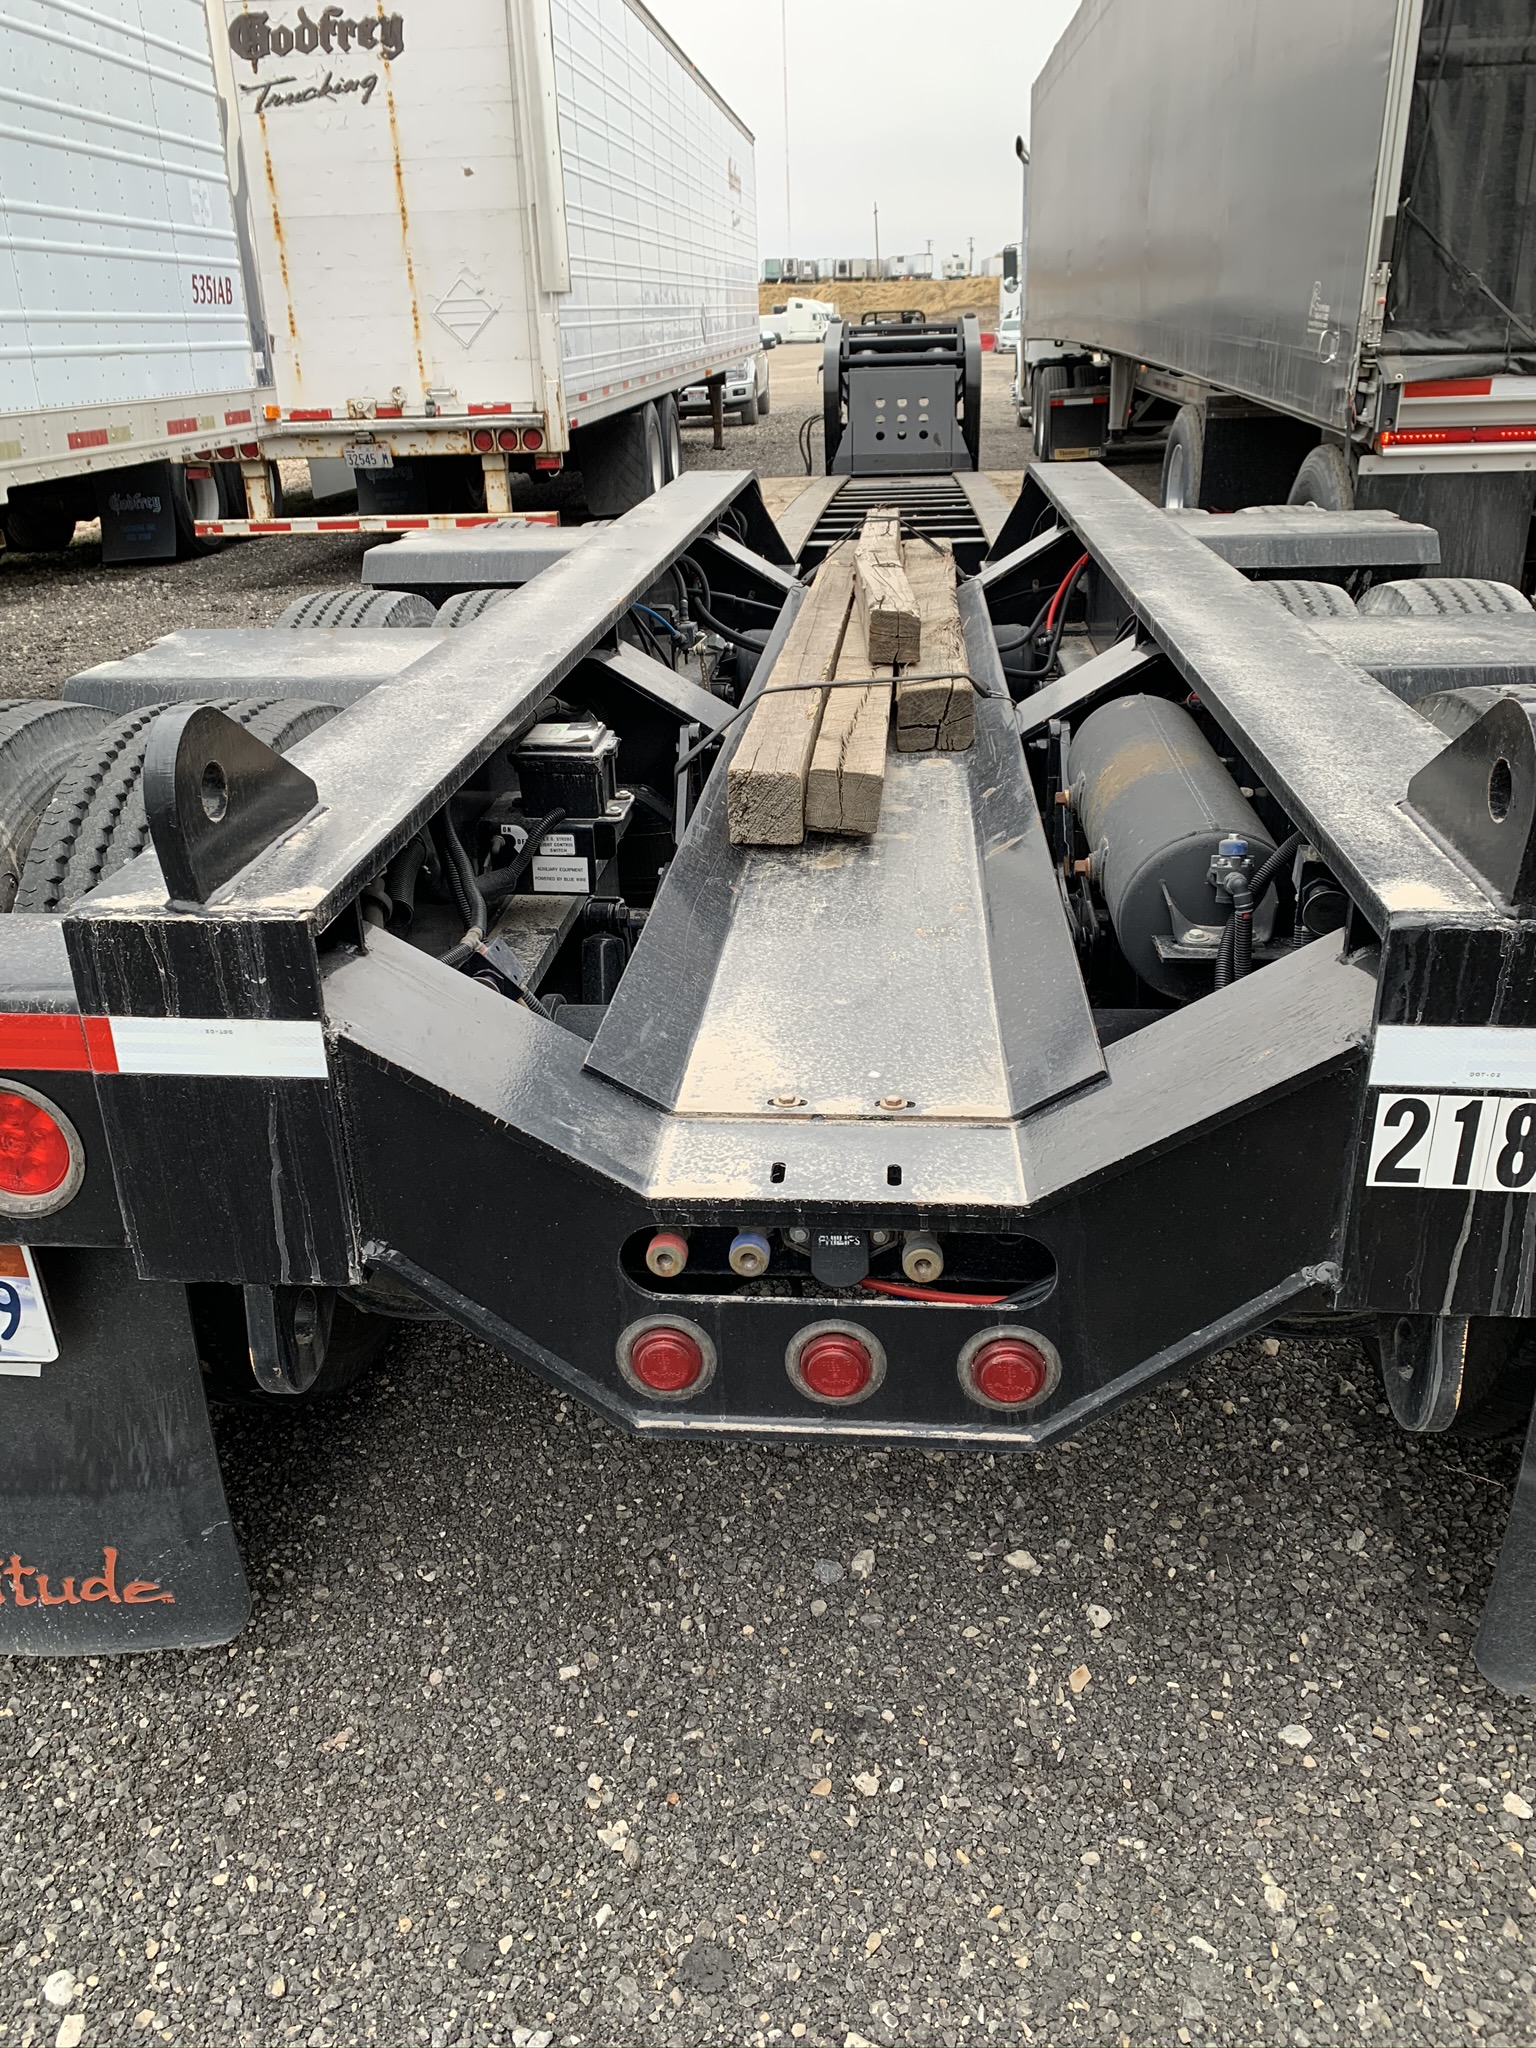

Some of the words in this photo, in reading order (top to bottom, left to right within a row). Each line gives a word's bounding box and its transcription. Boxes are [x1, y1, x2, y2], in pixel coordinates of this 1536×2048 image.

[228, 6, 404, 70] Godfrey
[238, 71, 378, 113] Trucking
[191, 273, 233, 305] 5351AB
[1374, 1098, 1536, 1188] 218
[0, 1546, 175, 1606] tude
